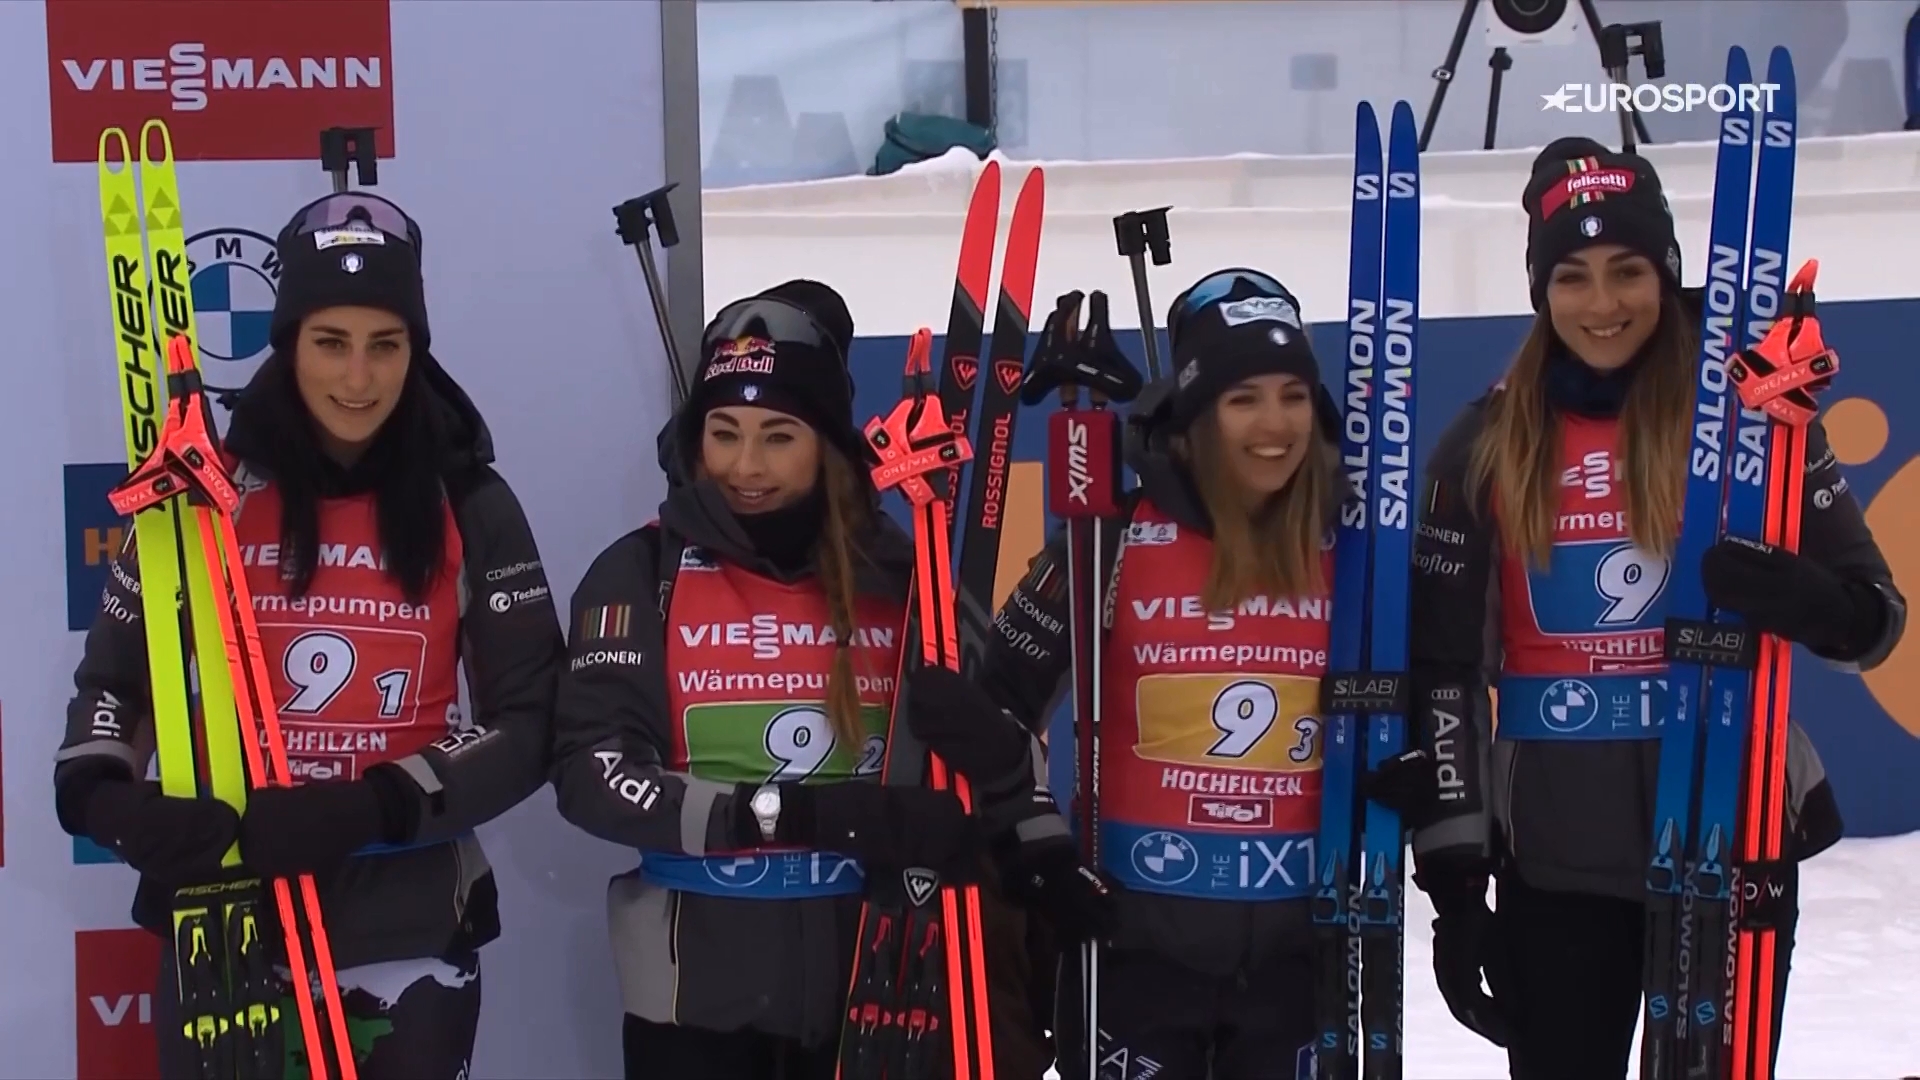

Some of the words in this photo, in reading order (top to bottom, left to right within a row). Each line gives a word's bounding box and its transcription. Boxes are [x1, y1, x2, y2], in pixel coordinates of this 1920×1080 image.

[62, 43, 382, 111] VIESSMANN
[1567, 174, 1627, 193] felicetti
[1691, 244, 1740, 483] SALOMON
[1734, 247, 1783, 487] SALMON
[1341, 298, 1377, 530] SALOMON
[1380, 298, 1414, 530] SALOMON
[982, 412, 1012, 529] ROSSIGNOL
[251, 593, 432, 623] rmepumpen
[1594, 543, 1673, 627] 9
[279, 630, 358, 717] 9
[373, 669, 411, 717] 1
[571, 651, 643, 672] FALCONERI
[678, 669, 893, 695] Wärmepupen
[1133, 642, 1327, 670] Wärmepumpe
[763, 705, 838, 784] 9
[1204, 680, 1280, 760] 9
[1287, 715, 1321, 764] 3
[1612, 695, 1631, 730] THE
[1161, 767, 1304, 796] HOCHFILZEN
[1432, 707, 1466, 801] Audi
[1202, 801, 1264, 823] Tirol
[174, 878, 261, 898] FISCHER
[783, 852, 802, 889] THE
[1211, 853, 1230, 889] THE
[1239, 837, 1317, 889] iX1
[1676, 861, 1697, 1040] SALOMON
[1723, 867, 1742, 1046] SALOMON
